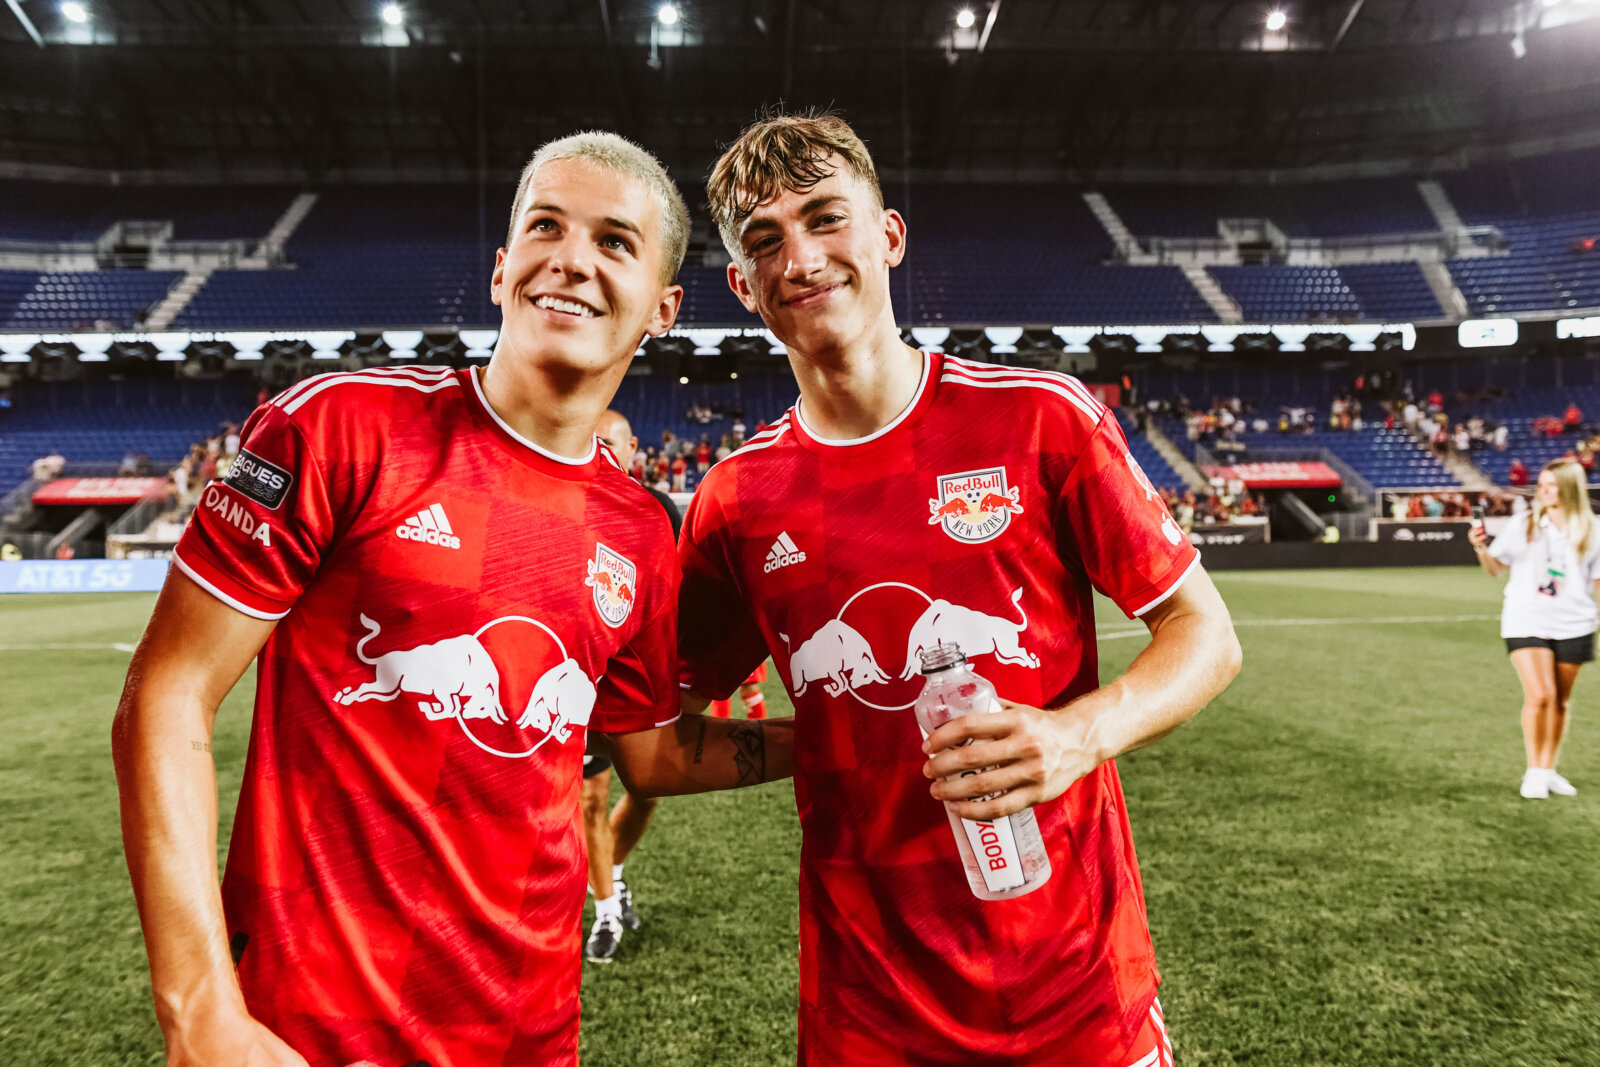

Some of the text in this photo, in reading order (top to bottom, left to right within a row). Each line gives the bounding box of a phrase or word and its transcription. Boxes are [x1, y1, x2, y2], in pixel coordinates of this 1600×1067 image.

[232, 454, 285, 490] EAGUES
[205, 487, 271, 547] OANDA
[396, 524, 461, 549] adidas
[764, 551, 807, 573] adidas
[18, 563, 133, 589] AT&T 5G
